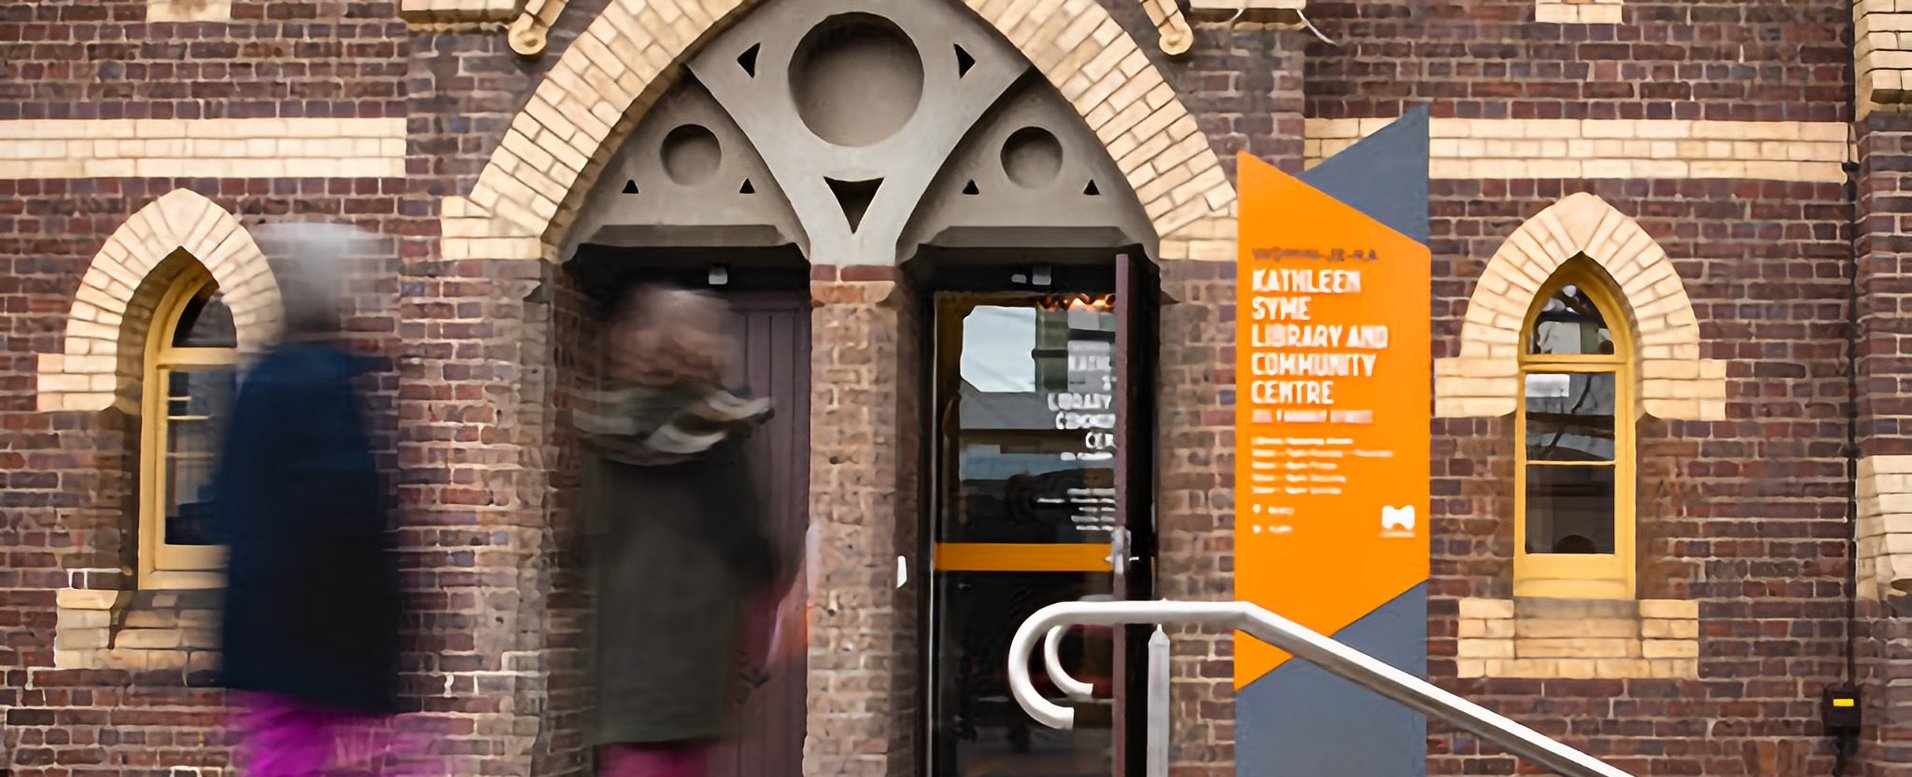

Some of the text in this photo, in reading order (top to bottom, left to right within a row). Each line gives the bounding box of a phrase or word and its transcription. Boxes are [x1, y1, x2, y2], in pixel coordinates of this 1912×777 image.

[1253, 269, 1360, 293] KATHLEEN
[1252, 297, 1311, 320] SYME
[1252, 324, 1388, 349] LIBRARY AND
[1252, 353, 1376, 376] COMMUNITY
[1252, 381, 1333, 404] CENTRE
